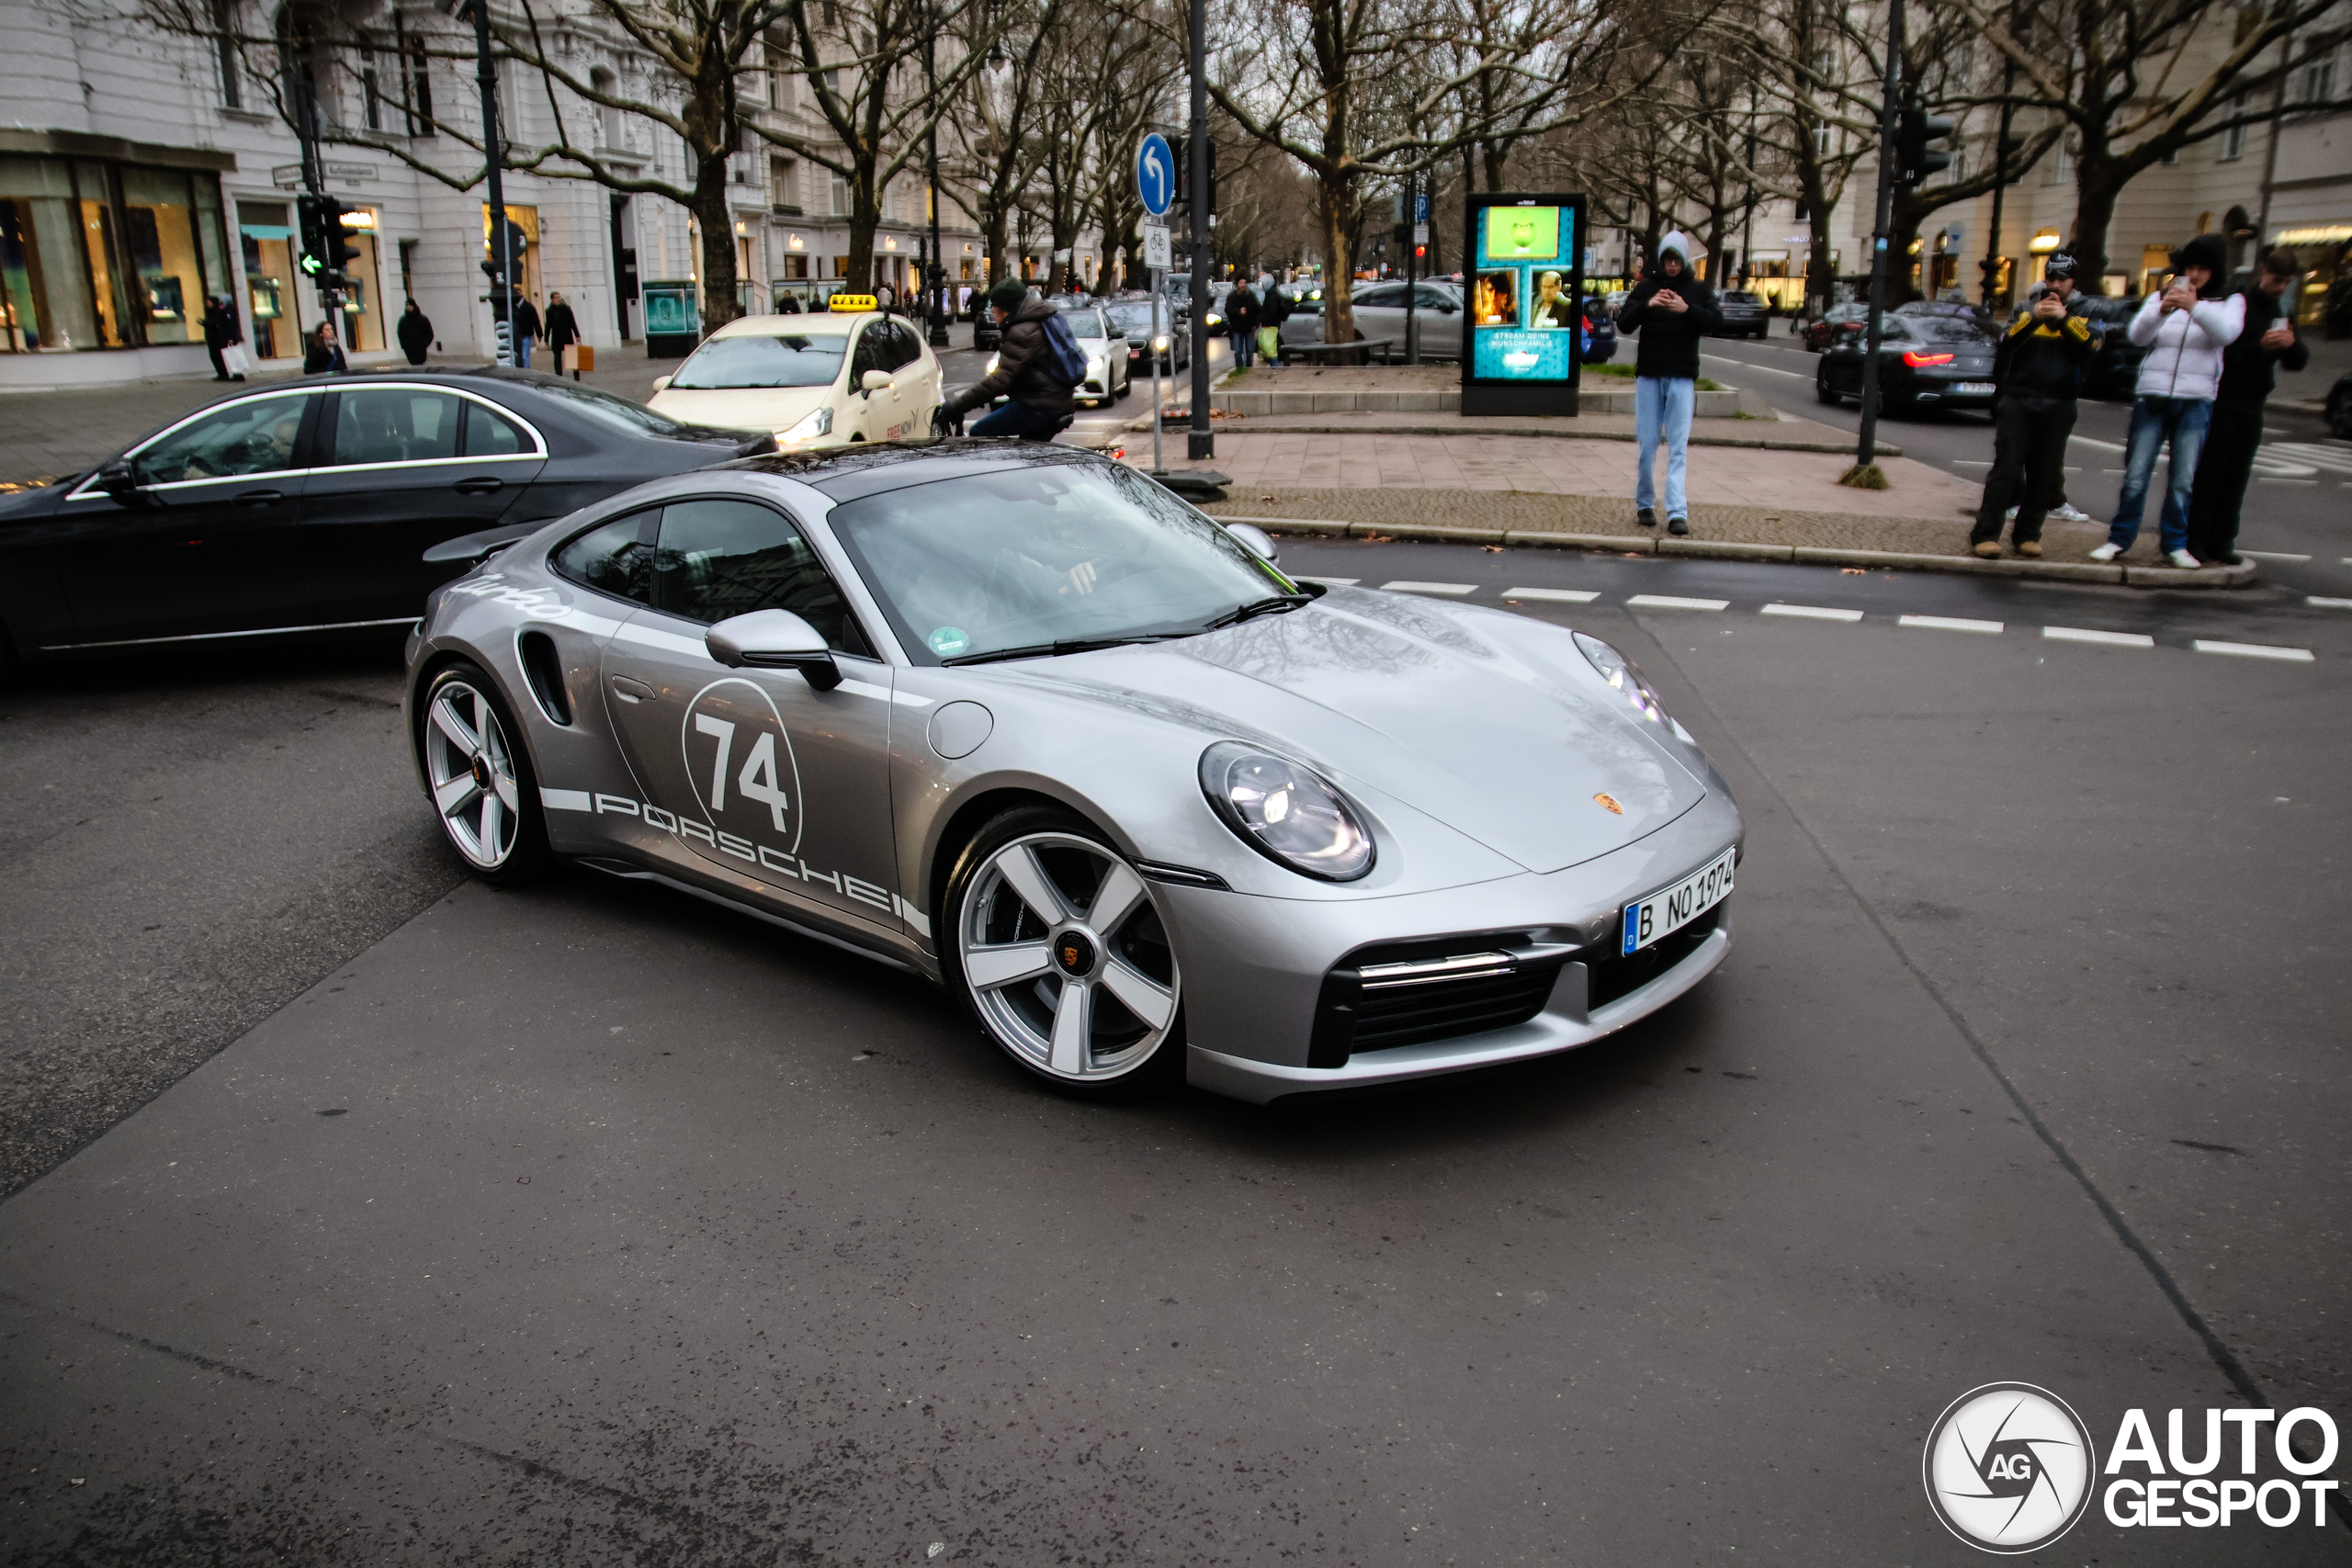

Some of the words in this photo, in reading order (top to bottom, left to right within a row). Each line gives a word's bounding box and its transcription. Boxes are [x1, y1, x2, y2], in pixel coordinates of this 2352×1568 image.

[1782, 235, 1811, 243] HUBLO
[1154, 252, 1164, 263] frei
[836, 296, 866, 305] TAXI
[695, 712, 789, 834] 74
[594, 793, 891, 912] PORSCHE
[1639, 904, 1654, 942] B
